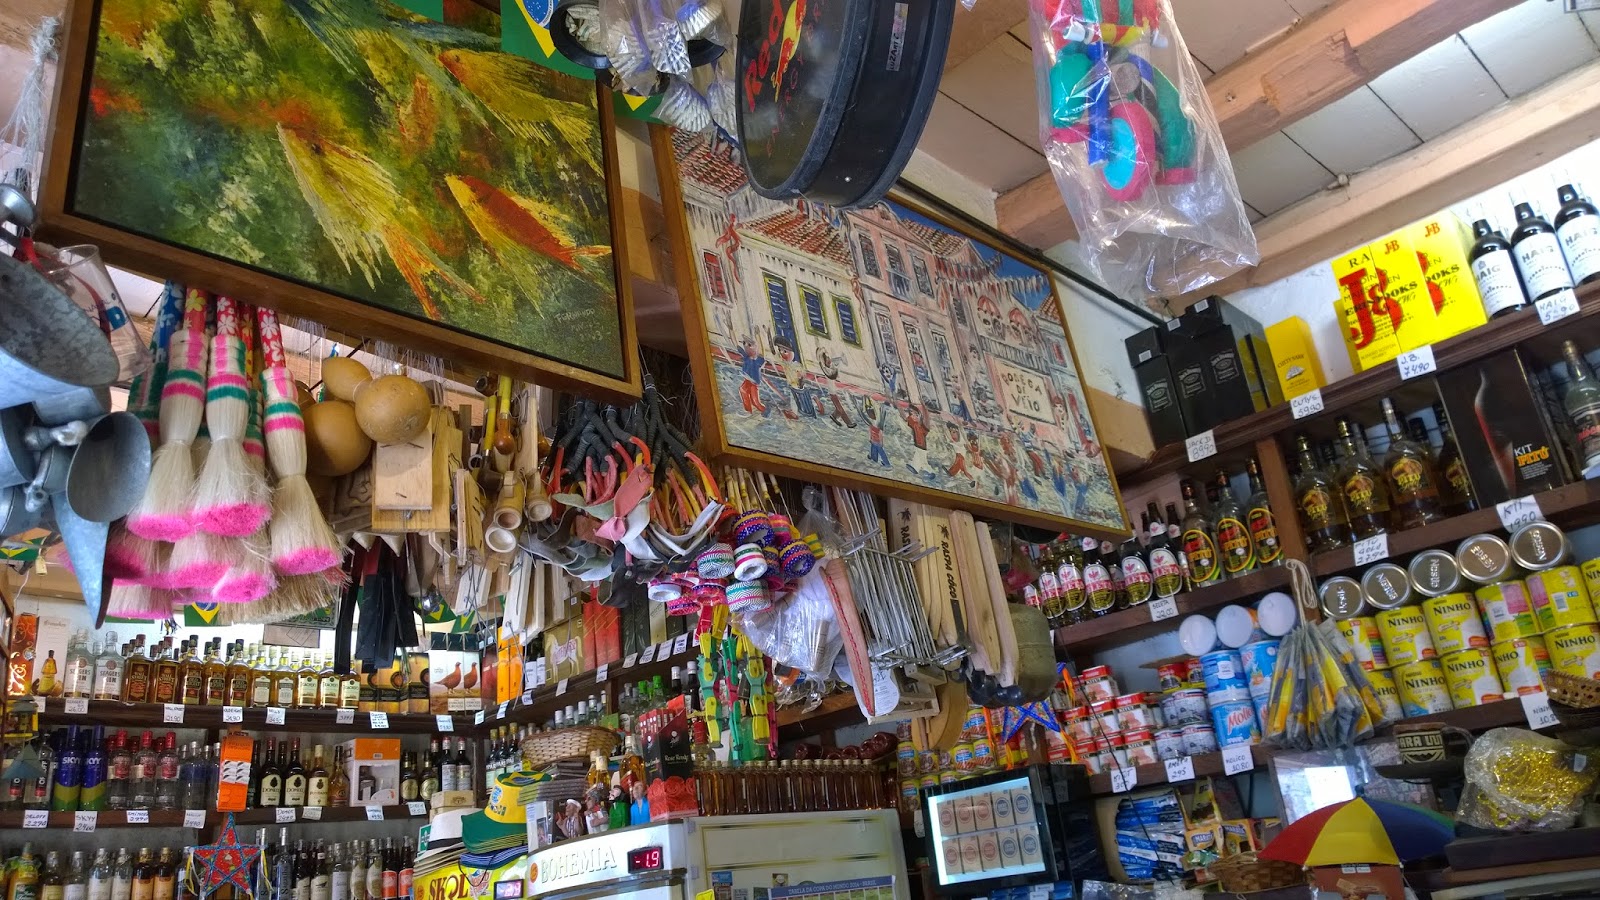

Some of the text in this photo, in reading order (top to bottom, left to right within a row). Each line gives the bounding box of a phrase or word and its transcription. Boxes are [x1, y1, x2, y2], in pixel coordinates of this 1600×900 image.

[1514, 443, 1532, 456] KIT
[941, 540, 958, 599] RASPA COCO
[1585, 569, 1600, 580] NIN
[1433, 602, 1472, 616] NINHO
[1388, 615, 1424, 628] NINHO
[1555, 635, 1596, 649] NINHO
[1447, 660, 1485, 673] NINHO
[1405, 676, 1445, 689] NINHO
[540, 846, 617, 884] BOHEMIA
[428, 873, 468, 900] SKOL
